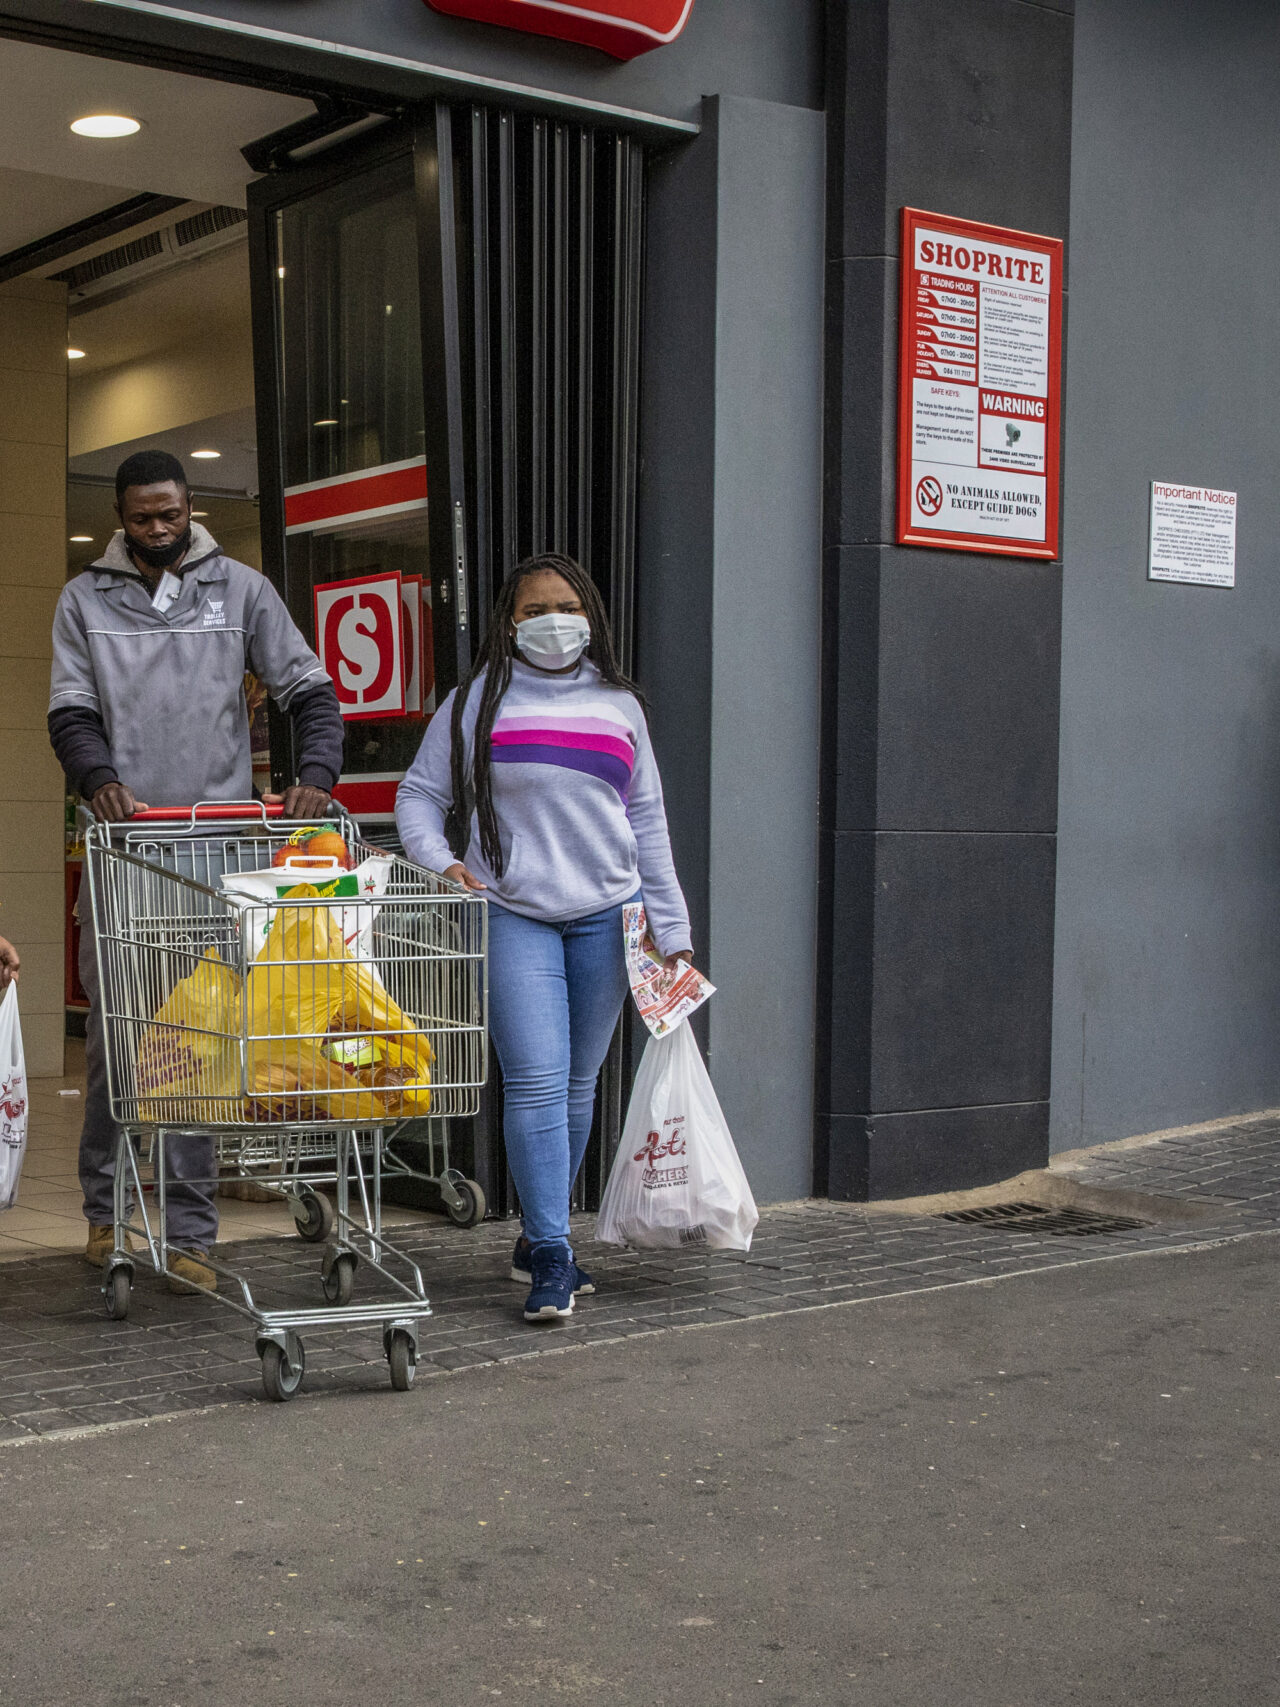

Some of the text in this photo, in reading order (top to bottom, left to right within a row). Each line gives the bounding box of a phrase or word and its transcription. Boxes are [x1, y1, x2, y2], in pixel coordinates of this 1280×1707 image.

[920, 240, 1044, 285] SHOPRITE
[931, 276, 955, 290] TRADING
[955, 282, 974, 293] HOURS
[982, 287, 1008, 297] ATTENTION
[1009, 291, 1017, 299] ALL
[1018, 294, 1047, 304] CUSTOMERS
[931, 387, 945, 396] SAFE
[982, 393, 1045, 418] WARNING
[946, 484, 1042, 506] NO ANIMALS ALLOWED,
[1153, 483, 1235, 506] Important Notice
[951, 498, 1038, 518] EXCEPT GUIDE DOGS
